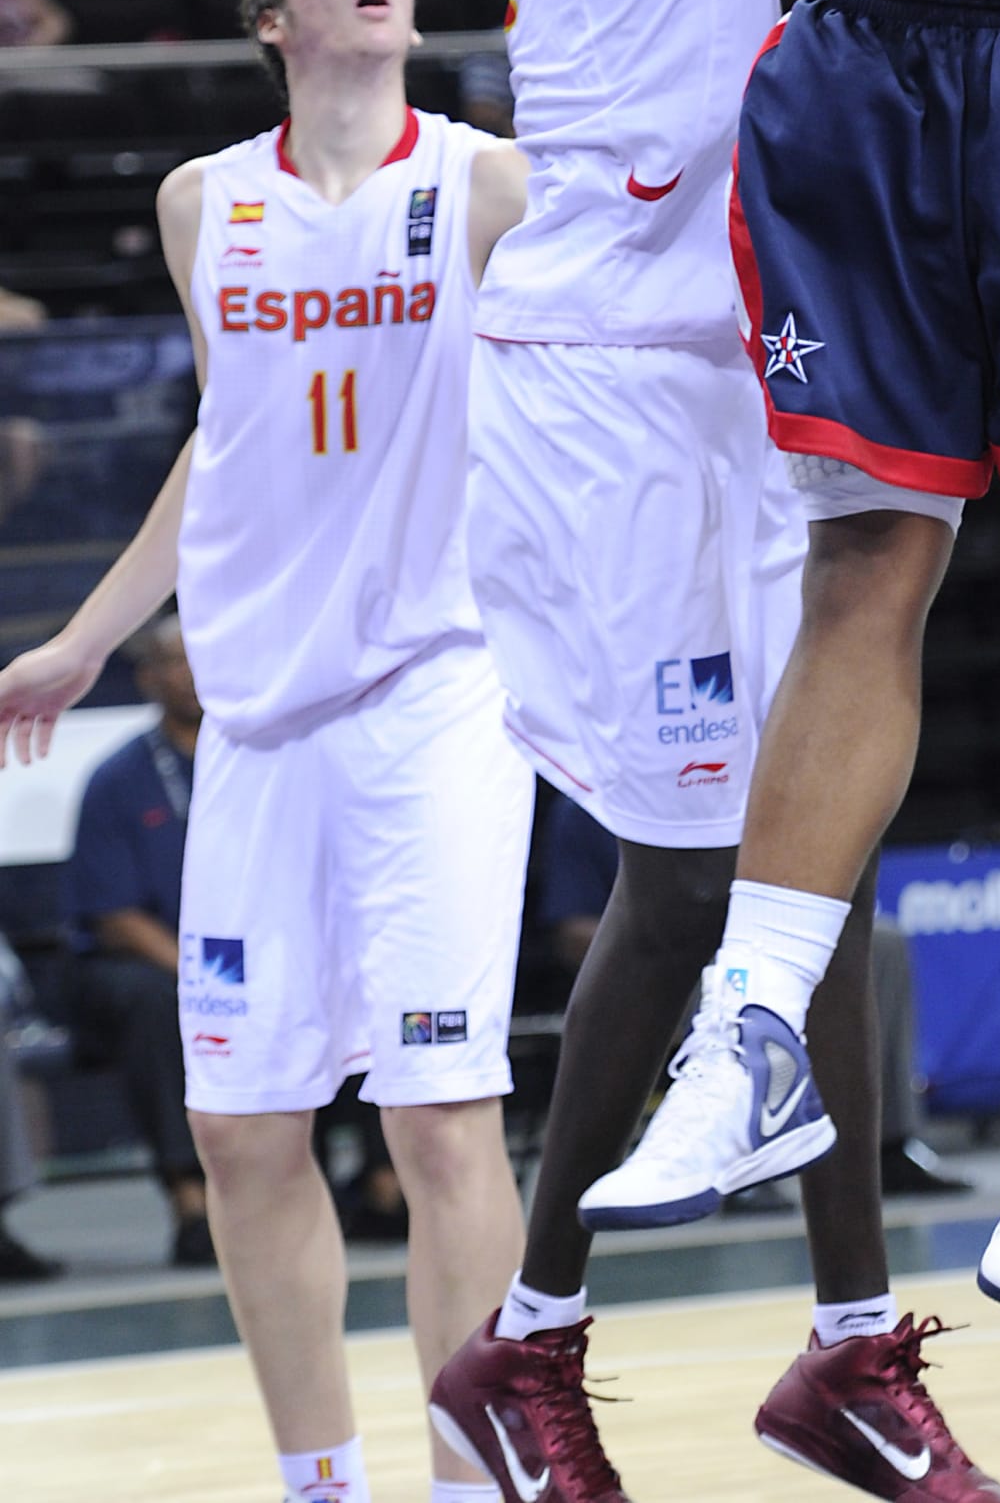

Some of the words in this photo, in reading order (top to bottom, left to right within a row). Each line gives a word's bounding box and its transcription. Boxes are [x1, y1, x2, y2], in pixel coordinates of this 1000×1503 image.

[218, 270, 438, 343] España
[306, 369, 358, 455] 11
[657, 717, 738, 745] endesa
